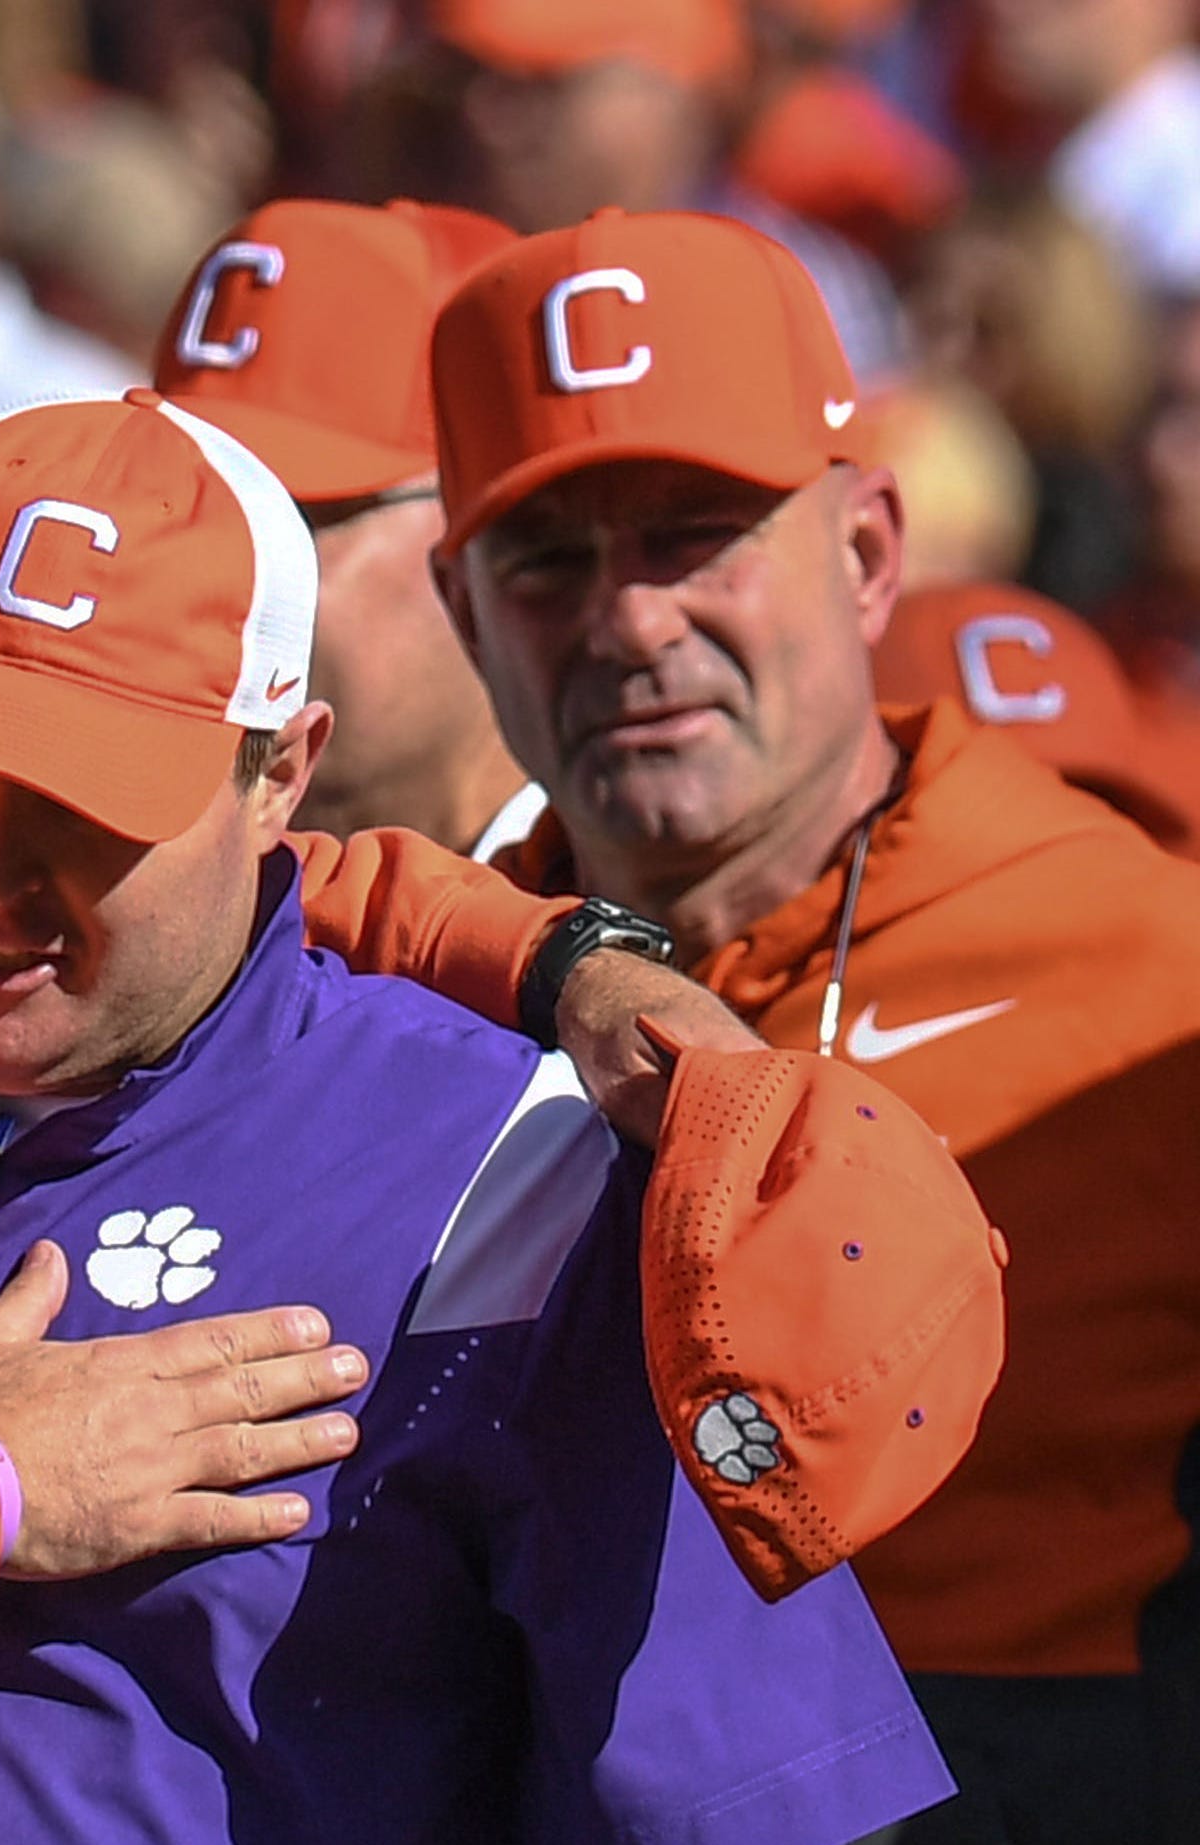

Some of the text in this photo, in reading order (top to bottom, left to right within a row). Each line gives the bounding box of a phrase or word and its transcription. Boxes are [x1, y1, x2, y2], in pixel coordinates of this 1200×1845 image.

[176, 241, 284, 368] C
[543, 268, 651, 392] C
[956, 614, 1067, 726] C
